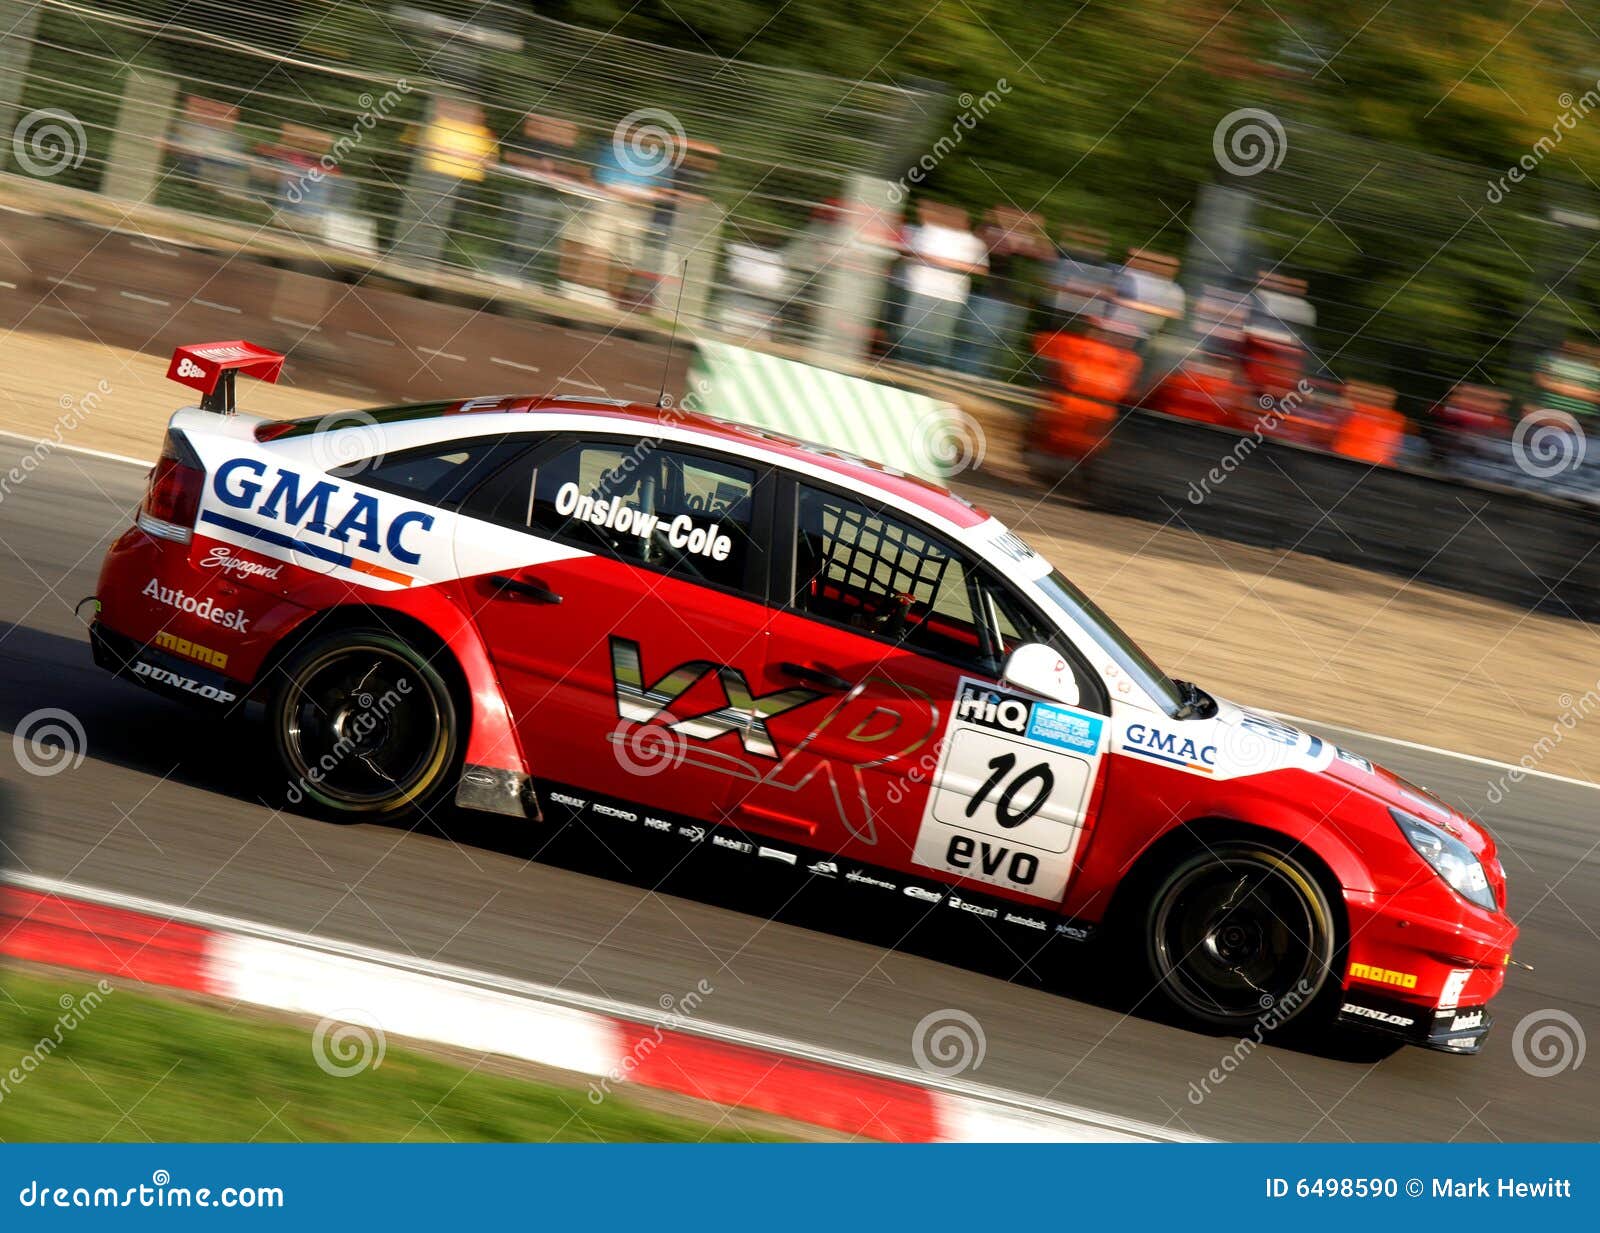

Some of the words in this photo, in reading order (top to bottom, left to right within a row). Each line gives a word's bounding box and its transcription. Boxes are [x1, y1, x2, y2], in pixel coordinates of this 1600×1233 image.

[213, 457, 436, 566] GMAC
[555, 482, 732, 562] Onslow-Cole
[142, 577, 250, 634] Autodesk
[132, 660, 237, 704] DUNLOP
[958, 686, 1028, 732] HiQ
[606, 633, 940, 846] VXR
[1126, 723, 1218, 765] GMAC
[965, 751, 1055, 829] 10
[644, 817, 672, 832] NGK
[946, 834, 1040, 887] evo
[1349, 962, 1418, 989] momo
[1340, 1002, 1415, 1027] DUNLOP
